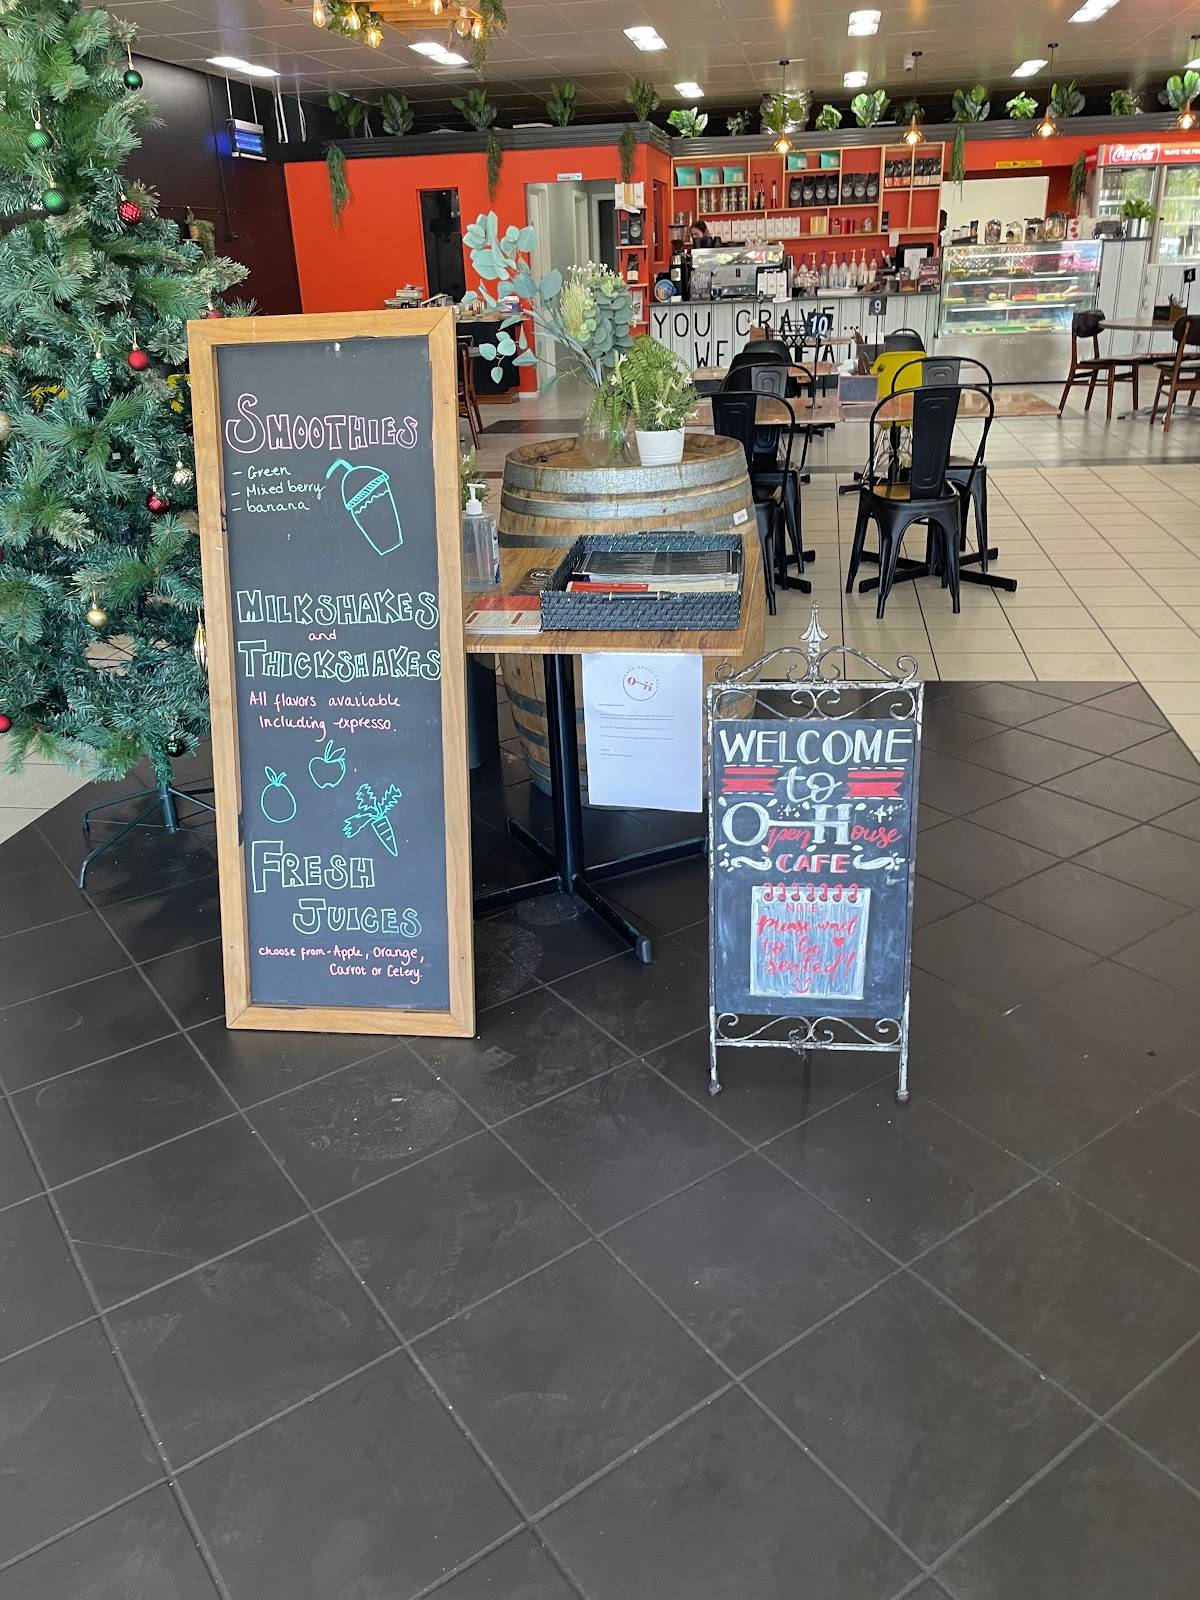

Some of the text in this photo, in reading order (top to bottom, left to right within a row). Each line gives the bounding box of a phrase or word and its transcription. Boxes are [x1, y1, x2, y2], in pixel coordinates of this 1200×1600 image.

[1186, 270, 1193, 281] 4
[874, 299, 882, 313] 9
[653, 312, 711, 338] YOU
[810, 315, 829, 335] 10
[225, 393, 418, 453] SMOOTHIES
[247, 465, 291, 479] Green
[246, 480, 327, 500] Mixed berry
[247, 501, 310, 513] banana
[236, 588, 439, 630] MILKSHAKES
[308, 629, 337, 641] and
[237, 640, 441, 682] THICKSHAKES
[249, 691, 401, 711] All flavors available
[259, 715, 397, 742] Including expresso.
[719, 728, 913, 765] WELCOME
[777, 766, 843, 803] to
[251, 840, 375, 893] FRESH
[775, 853, 851, 874] CAFE
[292, 898, 422, 938] JUICES
[817, 914, 858, 936] wait
[258, 945, 296, 957] choose
[373, 946, 424, 966] Orange,
[329, 963, 423, 985] Carrot or Celery.
